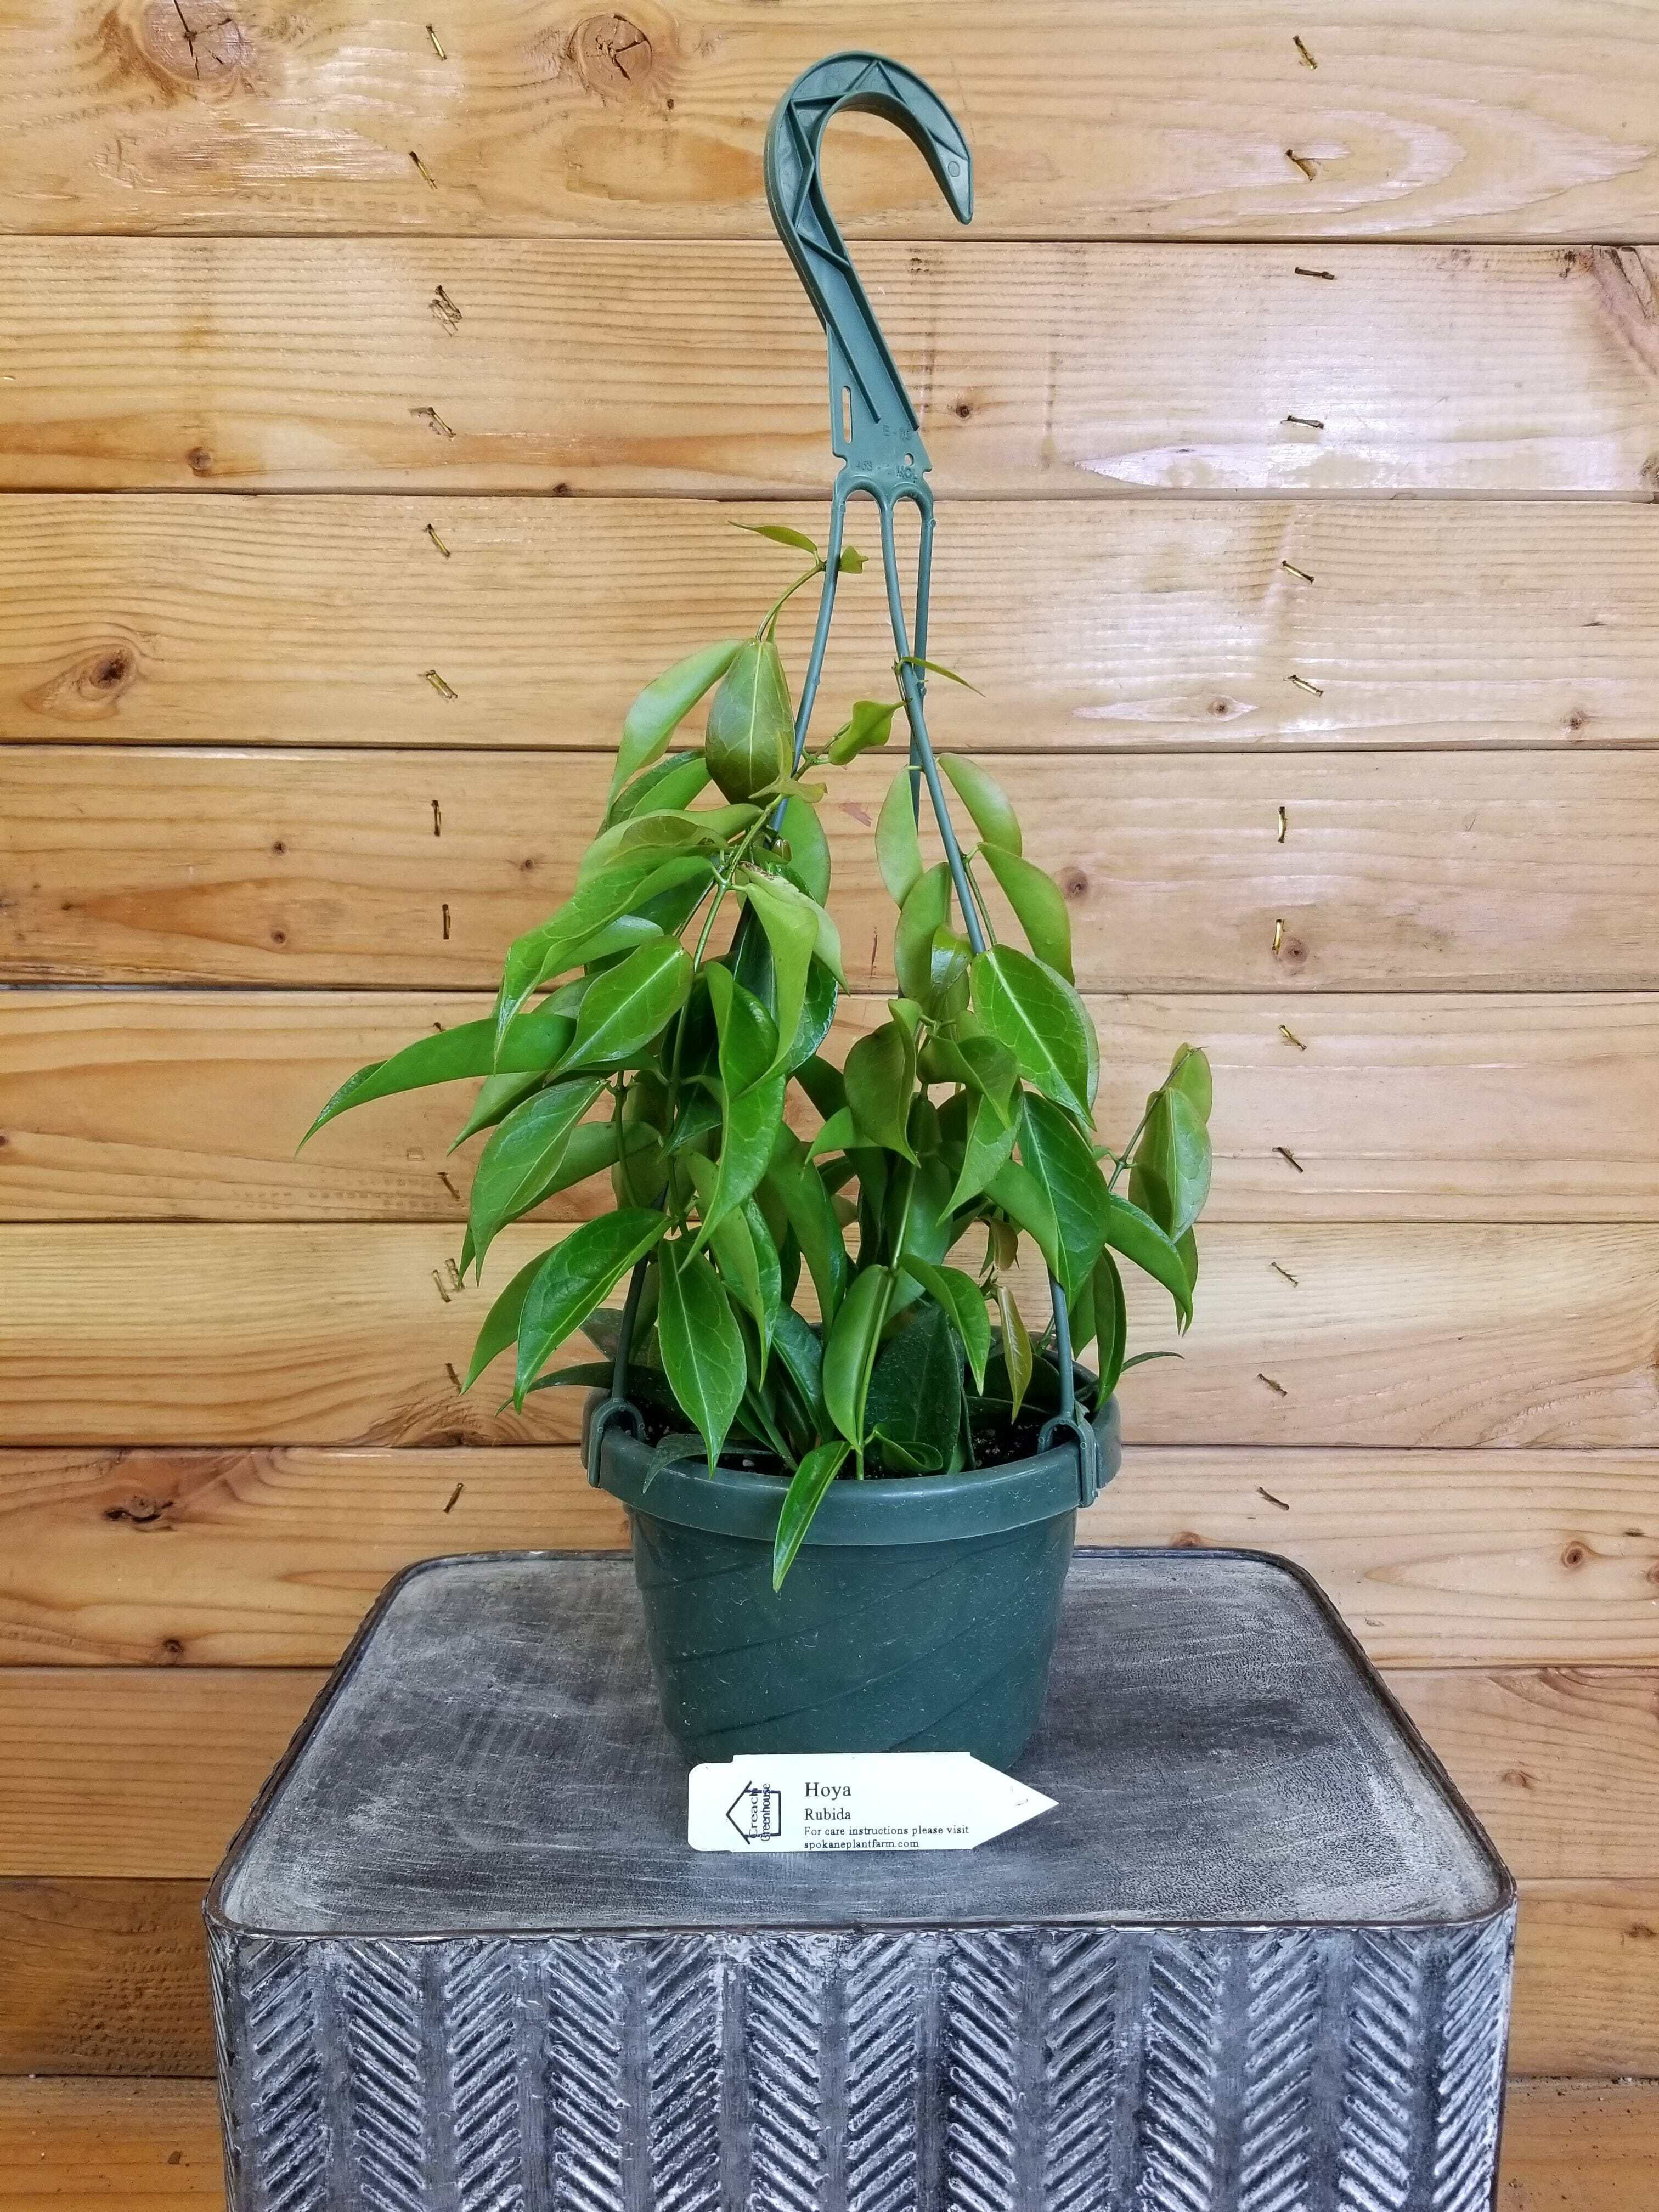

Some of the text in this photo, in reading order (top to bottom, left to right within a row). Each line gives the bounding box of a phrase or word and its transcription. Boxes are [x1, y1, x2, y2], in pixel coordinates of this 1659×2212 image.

[805, 1782, 852, 1800] Hoya
[760, 1782, 770, 1842] Greenhouse
[804, 1807, 852, 1820] Rubida
[804, 1826, 821, 1836] For
[849, 1827, 909, 1835] instructions
[912, 1825, 943, 1837] please
[946, 1825, 969, 1834] visit
[804, 1839, 919, 1850] spokaneplantfarm.com
